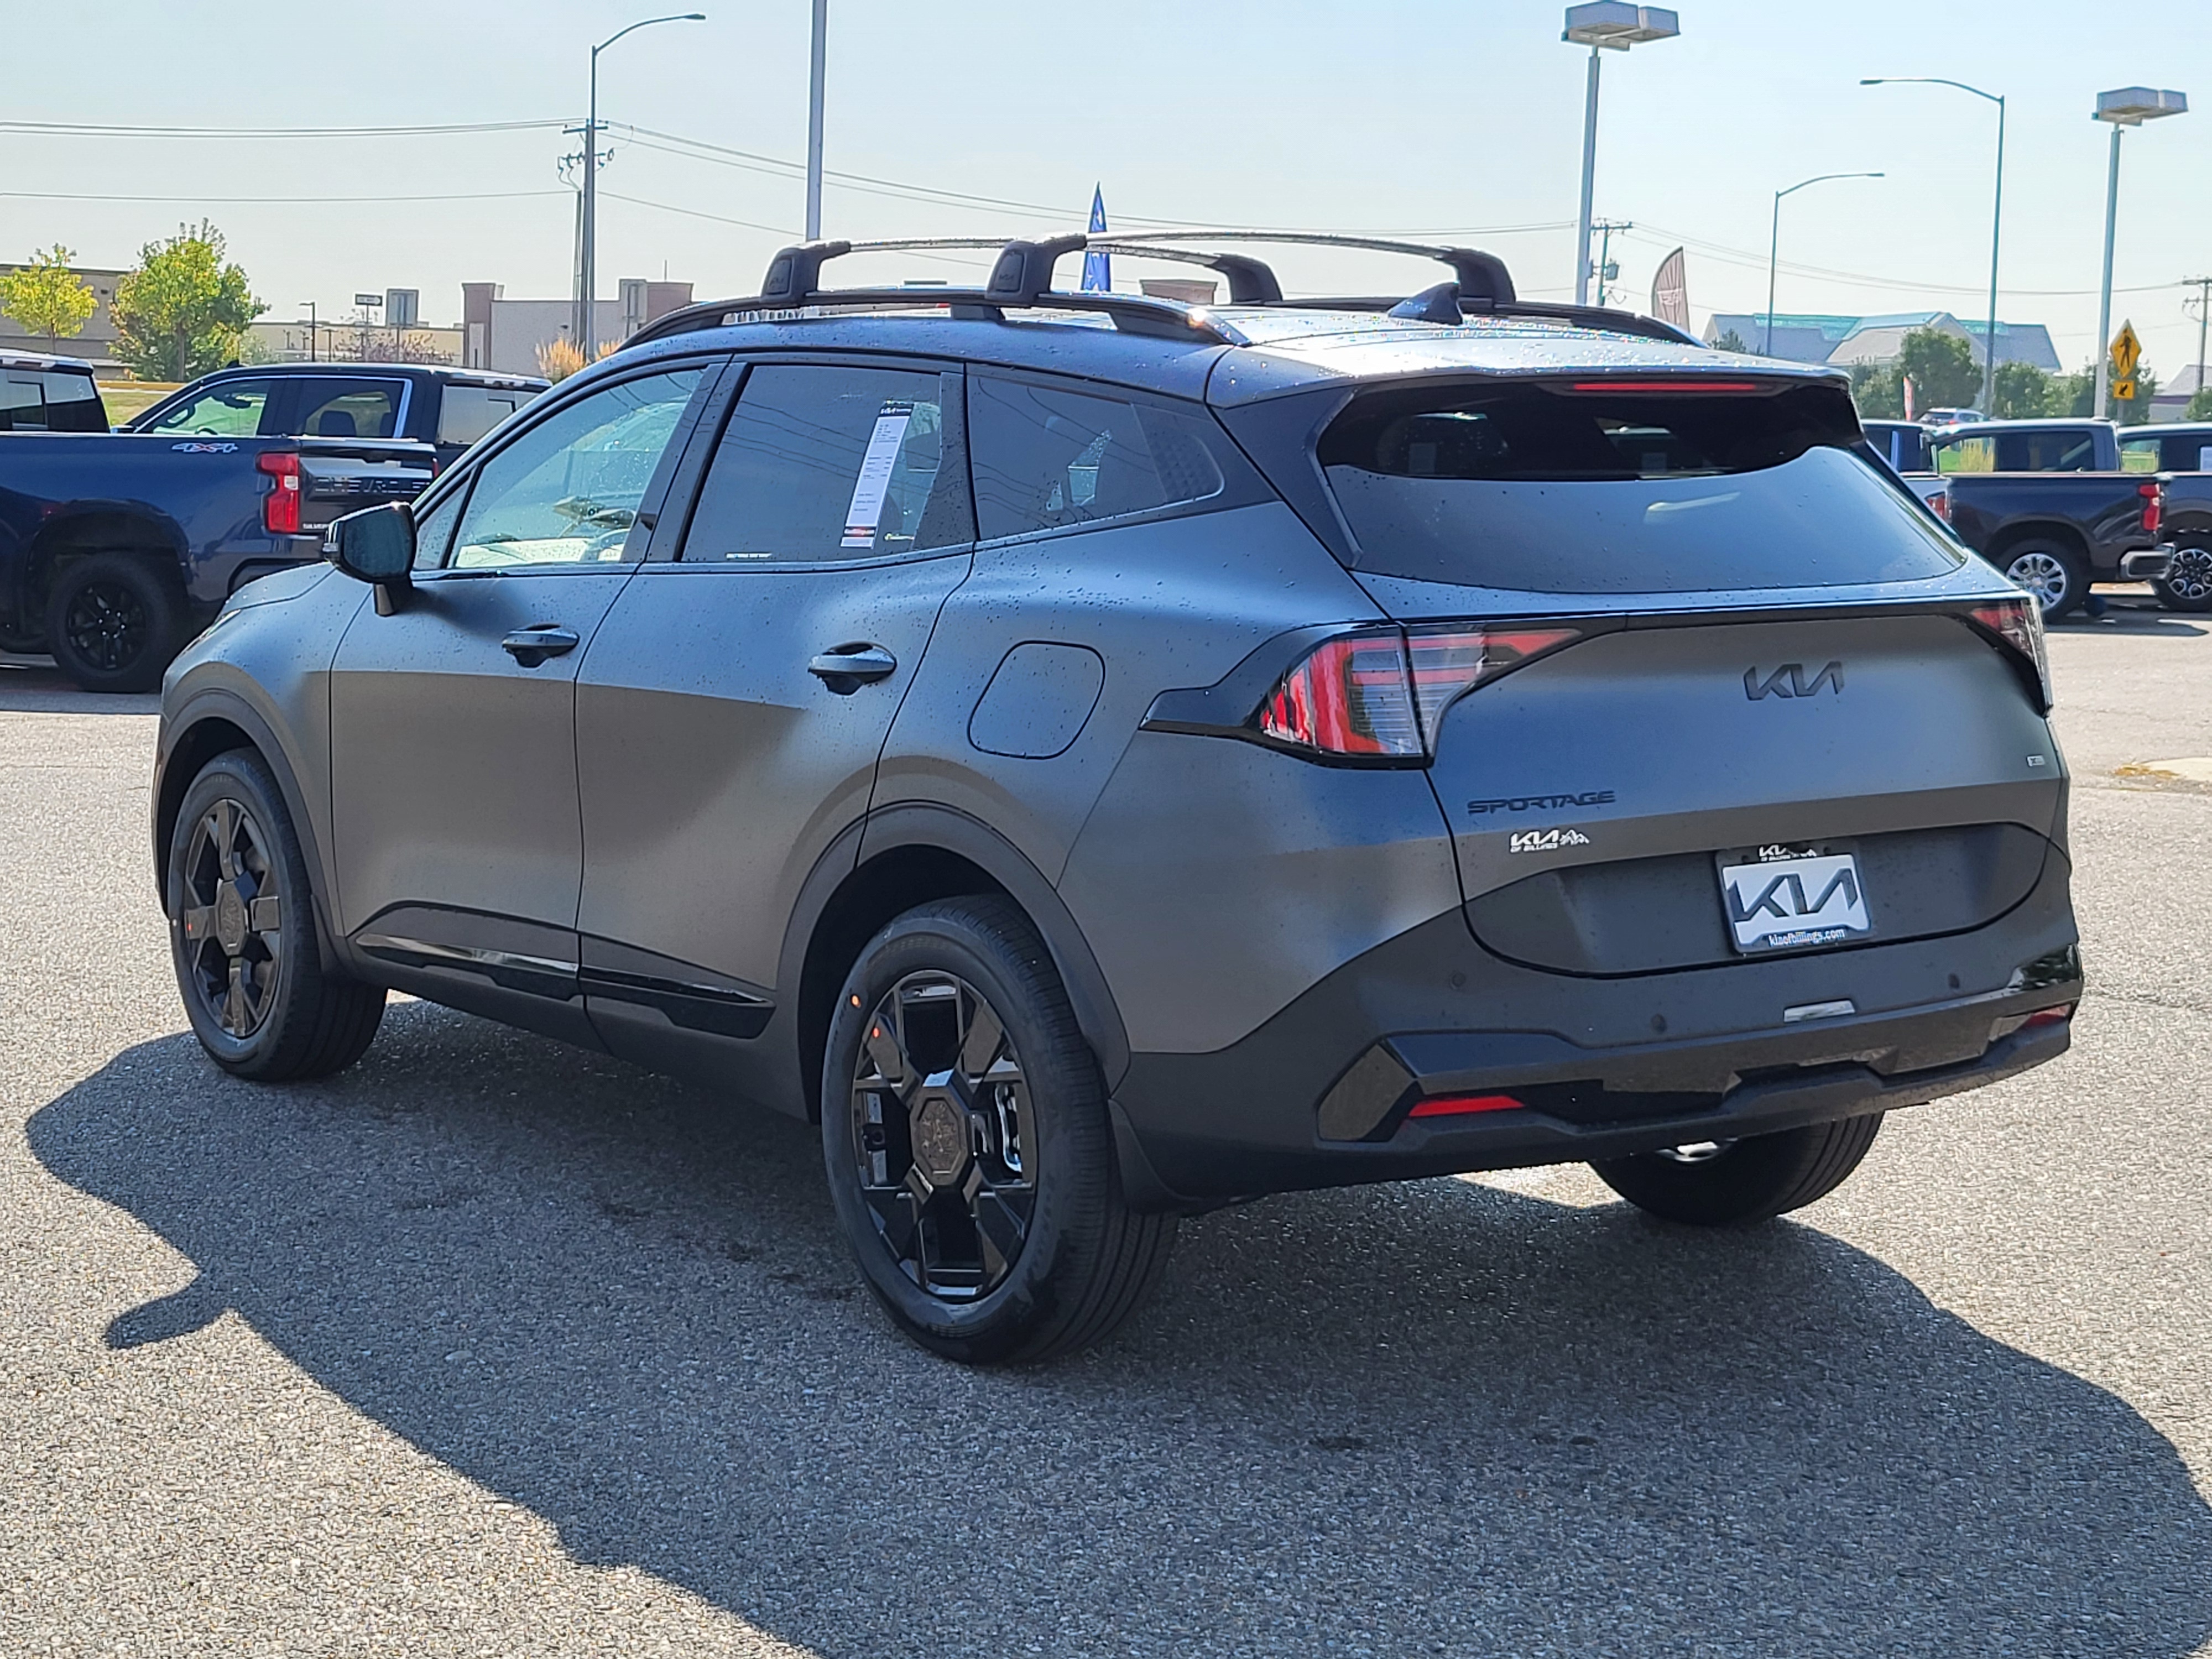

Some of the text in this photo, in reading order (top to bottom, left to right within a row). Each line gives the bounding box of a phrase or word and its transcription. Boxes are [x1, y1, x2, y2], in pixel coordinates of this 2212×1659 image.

[1744, 661, 1845, 701] KIA
[1467, 790, 1616, 814] SPORTAGE
[1510, 829, 1559, 846] KIA
[1726, 868, 1859, 923] KIA
